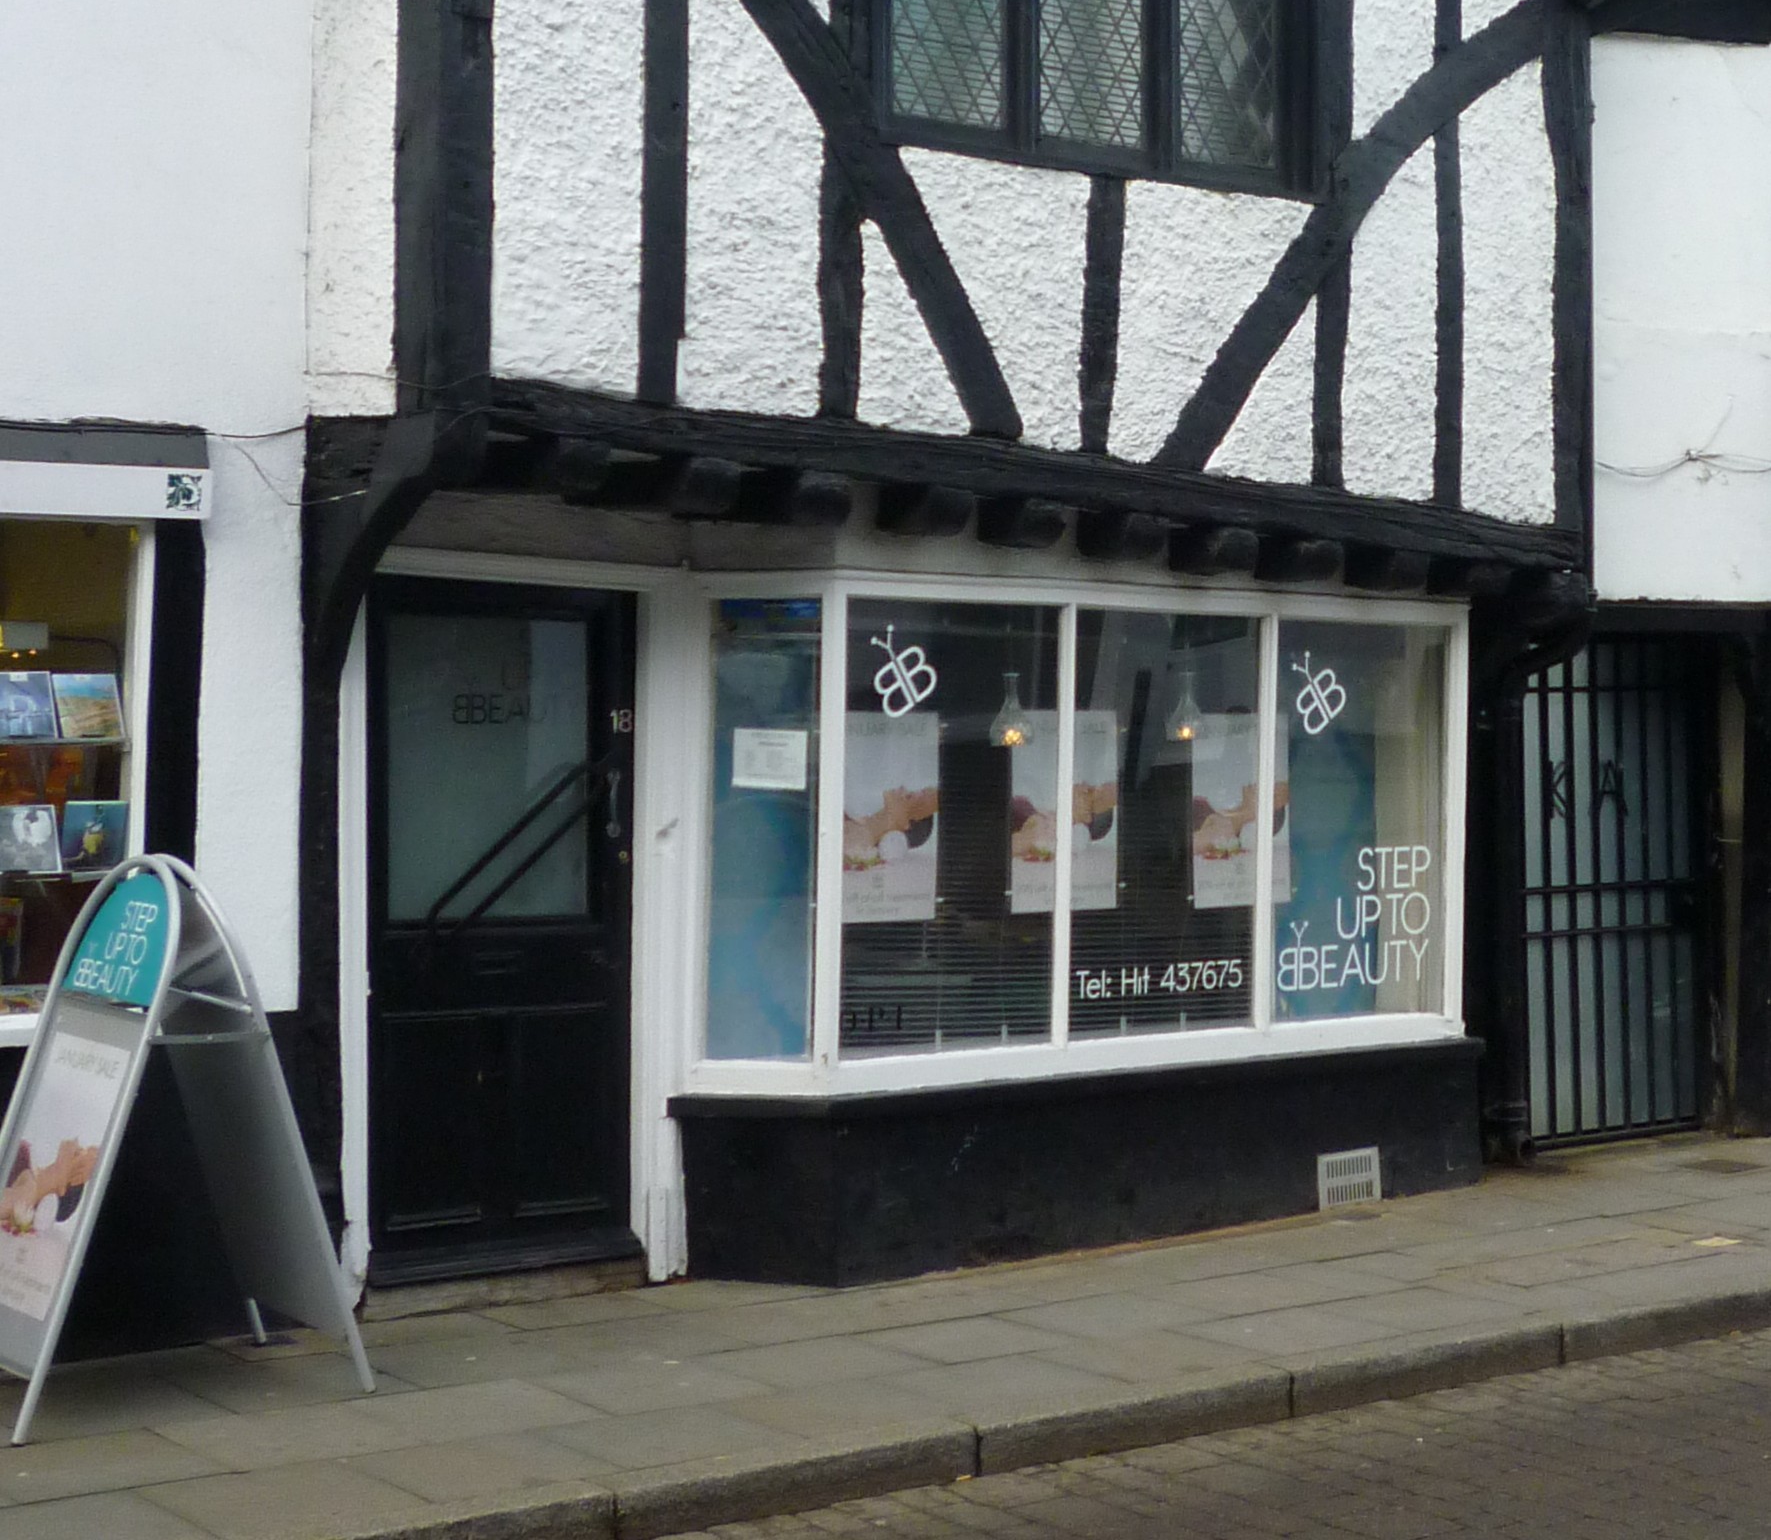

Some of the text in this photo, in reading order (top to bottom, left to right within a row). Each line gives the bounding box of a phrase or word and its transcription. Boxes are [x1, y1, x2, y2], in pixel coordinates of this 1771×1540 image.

[610, 709, 632, 734] 18
[1357, 845, 1431, 891] STEP
[121, 900, 158, 932] STEP
[1337, 892, 1430, 939] UP TO
[105, 932, 148, 965] UP TO
[1076, 969, 1112, 999] Tel:
[1159, 959, 1243, 992] 437675
